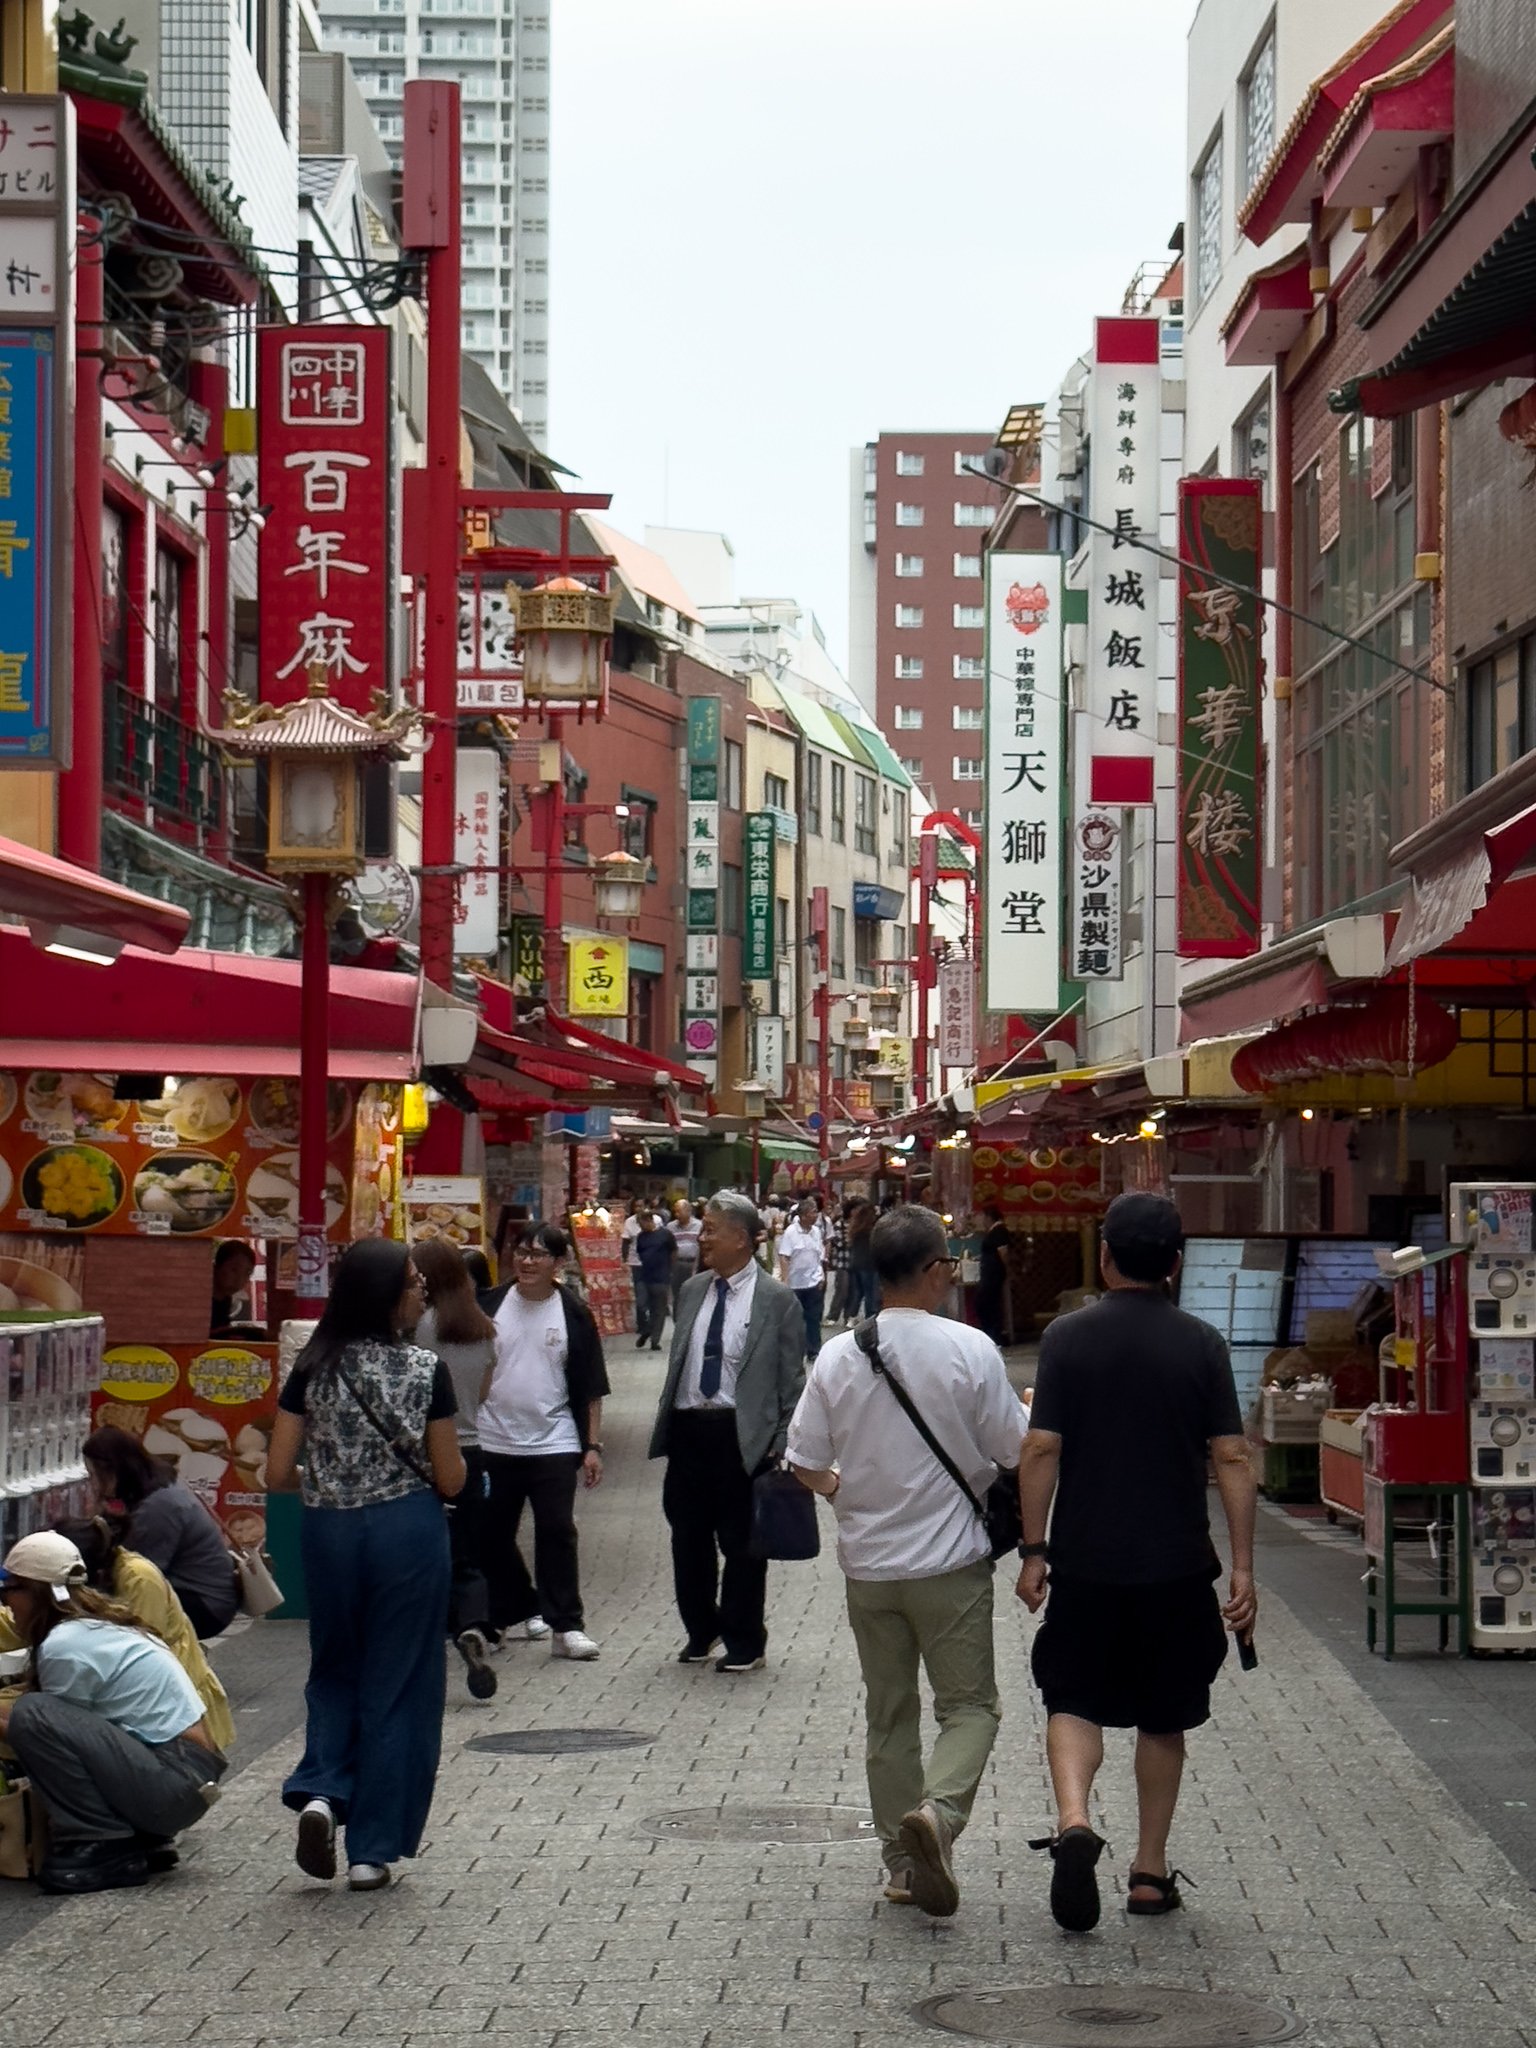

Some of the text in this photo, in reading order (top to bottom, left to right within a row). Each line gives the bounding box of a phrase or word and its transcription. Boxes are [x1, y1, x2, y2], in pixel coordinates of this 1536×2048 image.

[1102, 507, 1147, 732] 長城飯店
[1000, 750, 1048, 935] 天獅堂
[582, 965, 615, 991] 西
